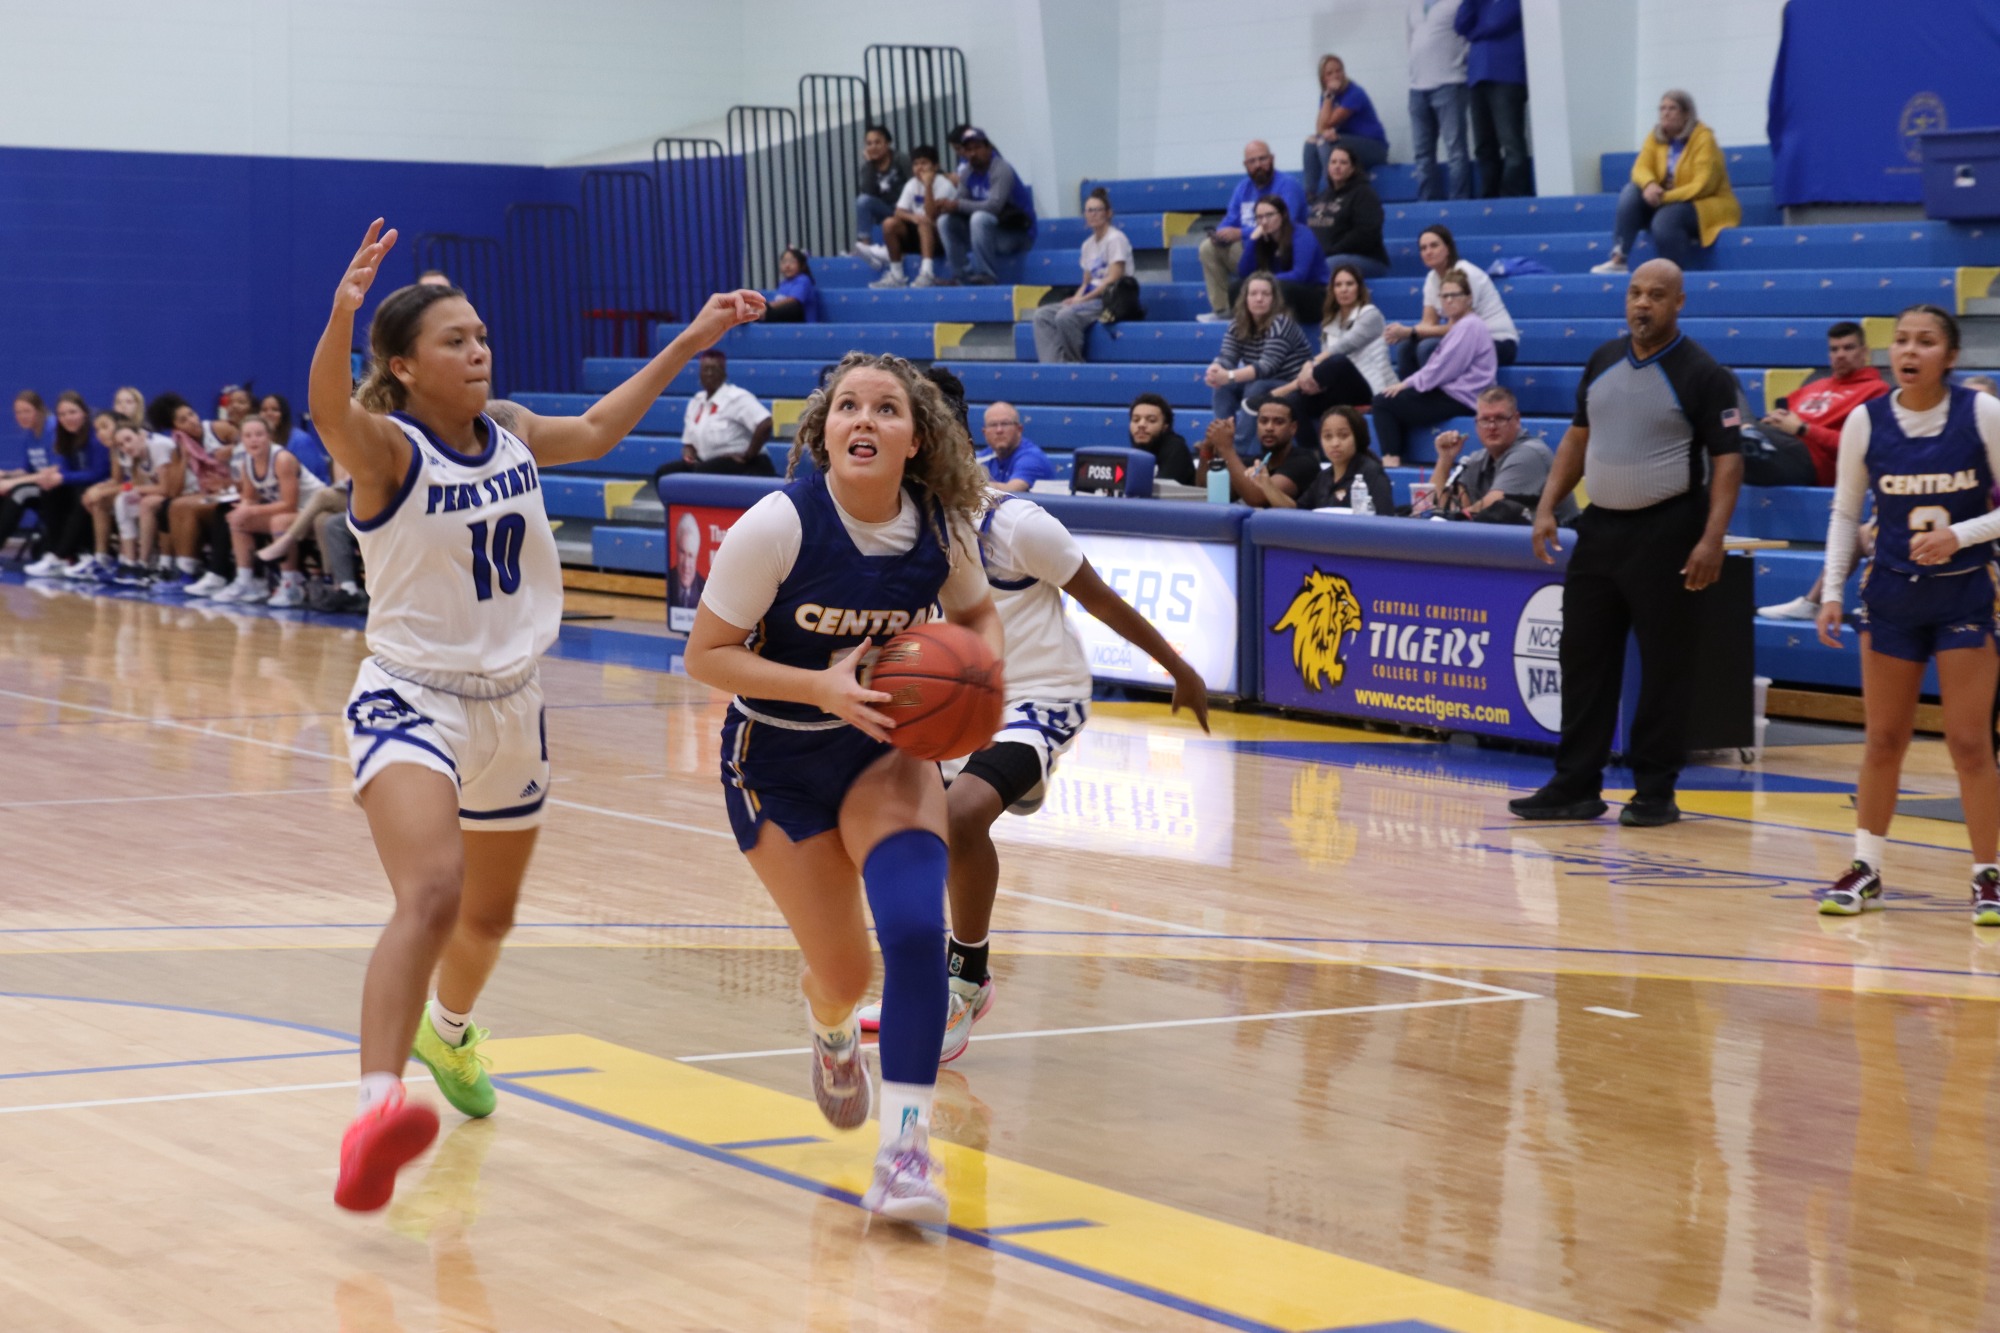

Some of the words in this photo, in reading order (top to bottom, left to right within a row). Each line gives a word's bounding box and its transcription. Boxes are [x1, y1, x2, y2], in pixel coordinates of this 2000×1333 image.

[1087, 465, 1113, 480] POSS.
[1878, 469, 1979, 495] CENTRAL
[467, 512, 526, 602] 10
[1373, 600, 1420, 617] CENTRAL
[1426, 605, 1488, 623] CHRISTIAN
[1368, 622, 1491, 669] TIGERS
[1528, 626, 1561, 648] NCC
[1372, 663, 1419, 682] COLLEGE
[1424, 670, 1437, 684] OF
[1443, 672, 1487, 690] KANSAS
[1528, 667, 1560, 700] NA
[1355, 689, 1510, 725] www.ccctigers.com
